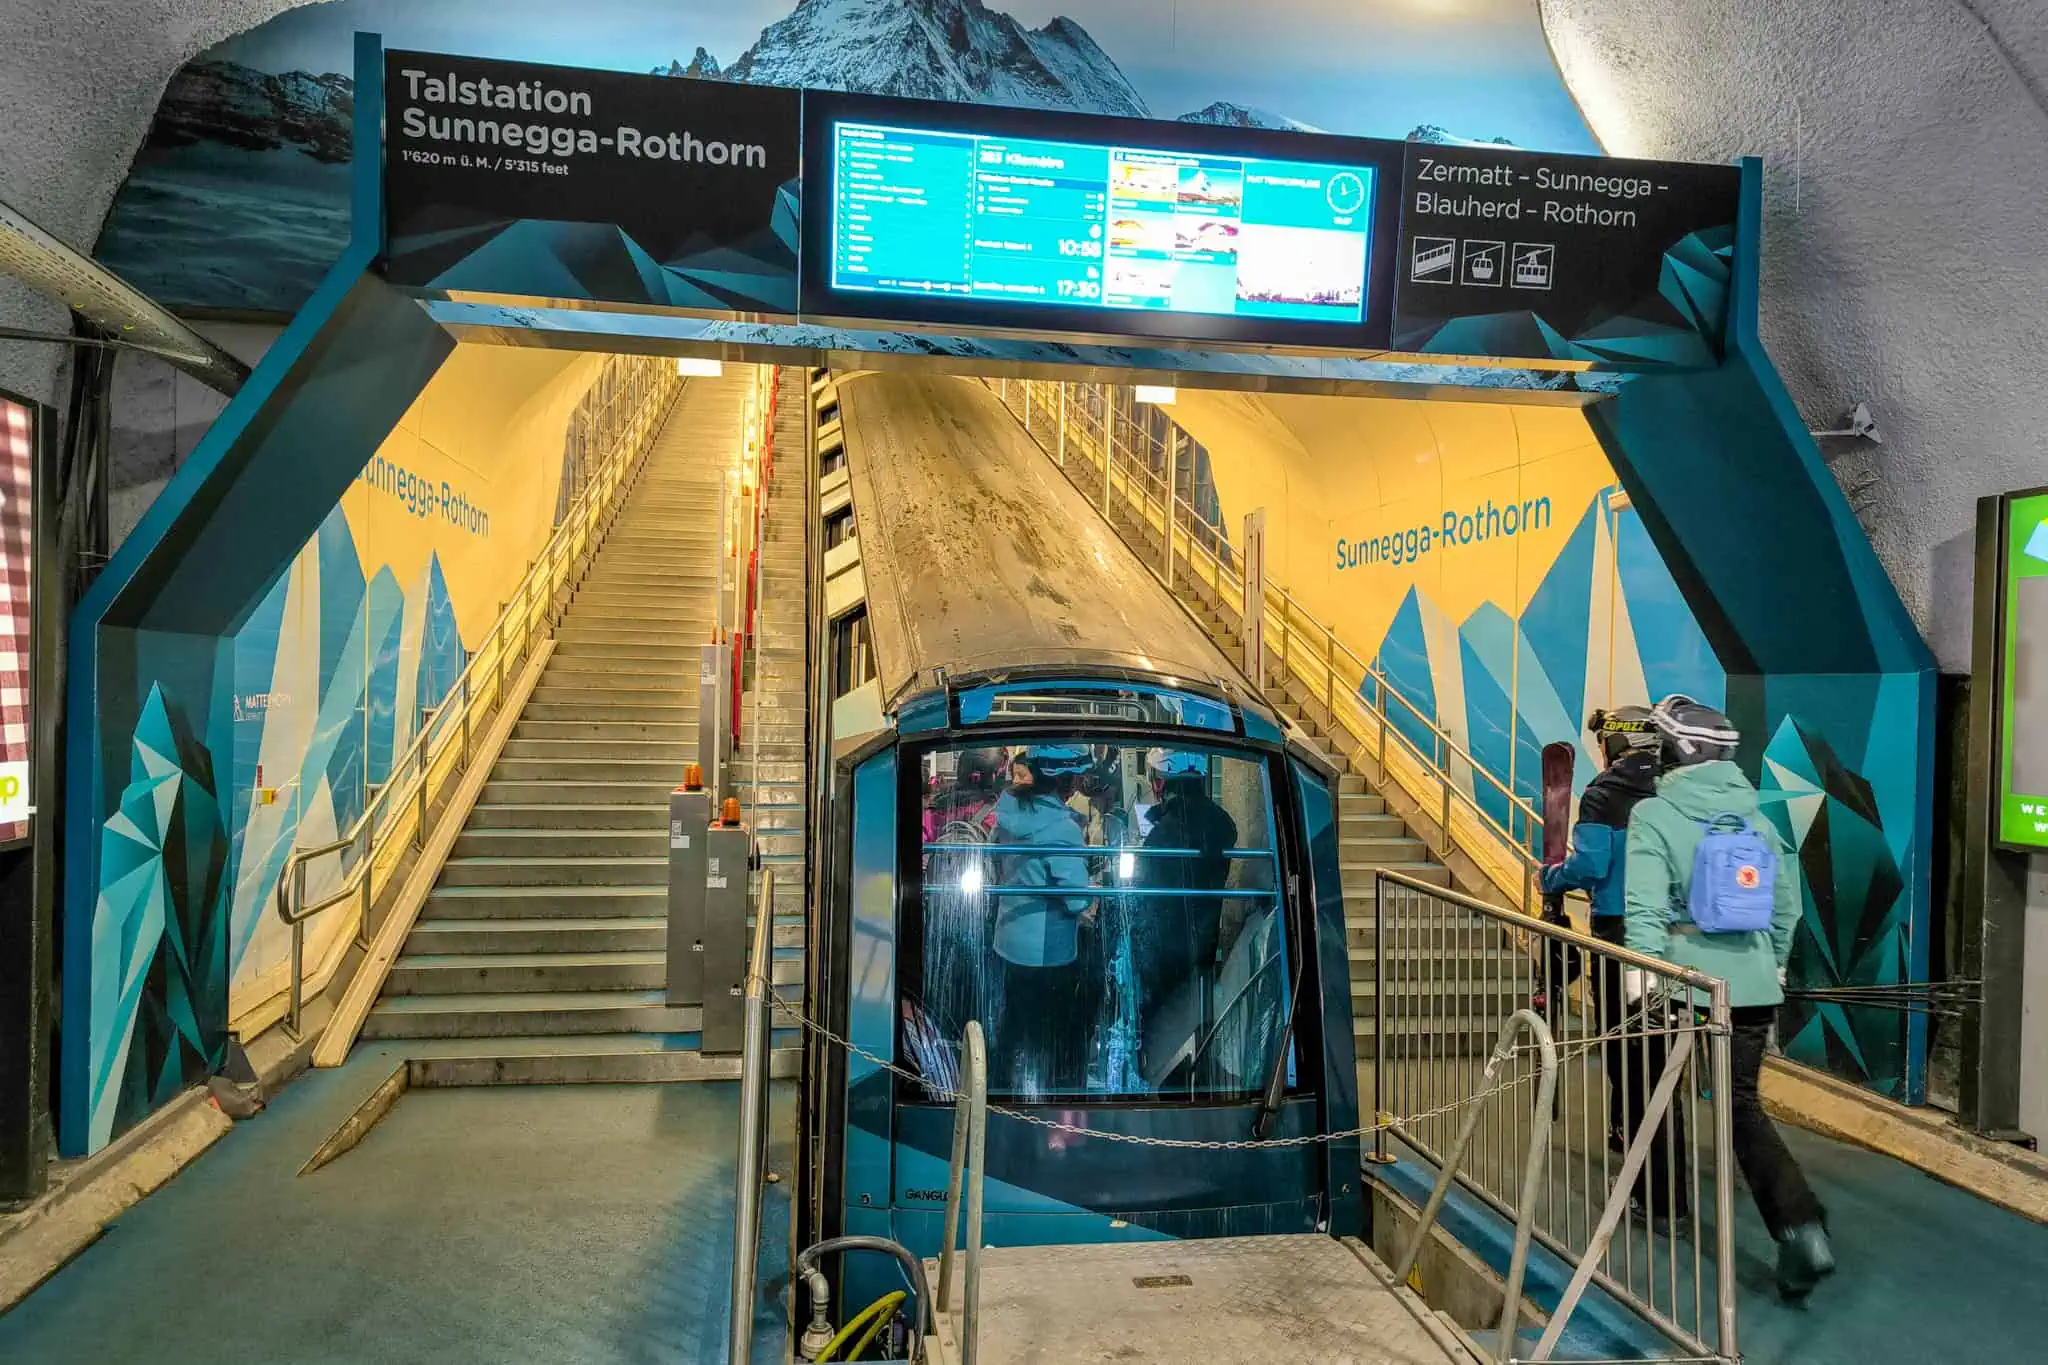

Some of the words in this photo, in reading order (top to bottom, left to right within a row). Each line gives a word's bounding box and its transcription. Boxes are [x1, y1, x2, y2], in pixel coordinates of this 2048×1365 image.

[401, 69, 592, 116] Talstation
[402, 107, 766, 169] Sunnegga-Rothorn
[402, 149, 441, 165] 1'620
[442, 155, 457, 166] m
[460, 154, 473, 167] ü.
[475, 156, 492, 169] M.
[504, 158, 540, 173] 5'315
[541, 161, 569, 176] feet
[1417, 158, 1513, 187] Zermatt
[1535, 167, 1652, 199] Sunnegga
[1415, 191, 1521, 220] Blauherd
[1543, 200, 1636, 227] Rothorn
[357, 456, 489, 537] unnegga-Rothorn
[1336, 496, 1551, 571] Sunnegga-Rothorn
